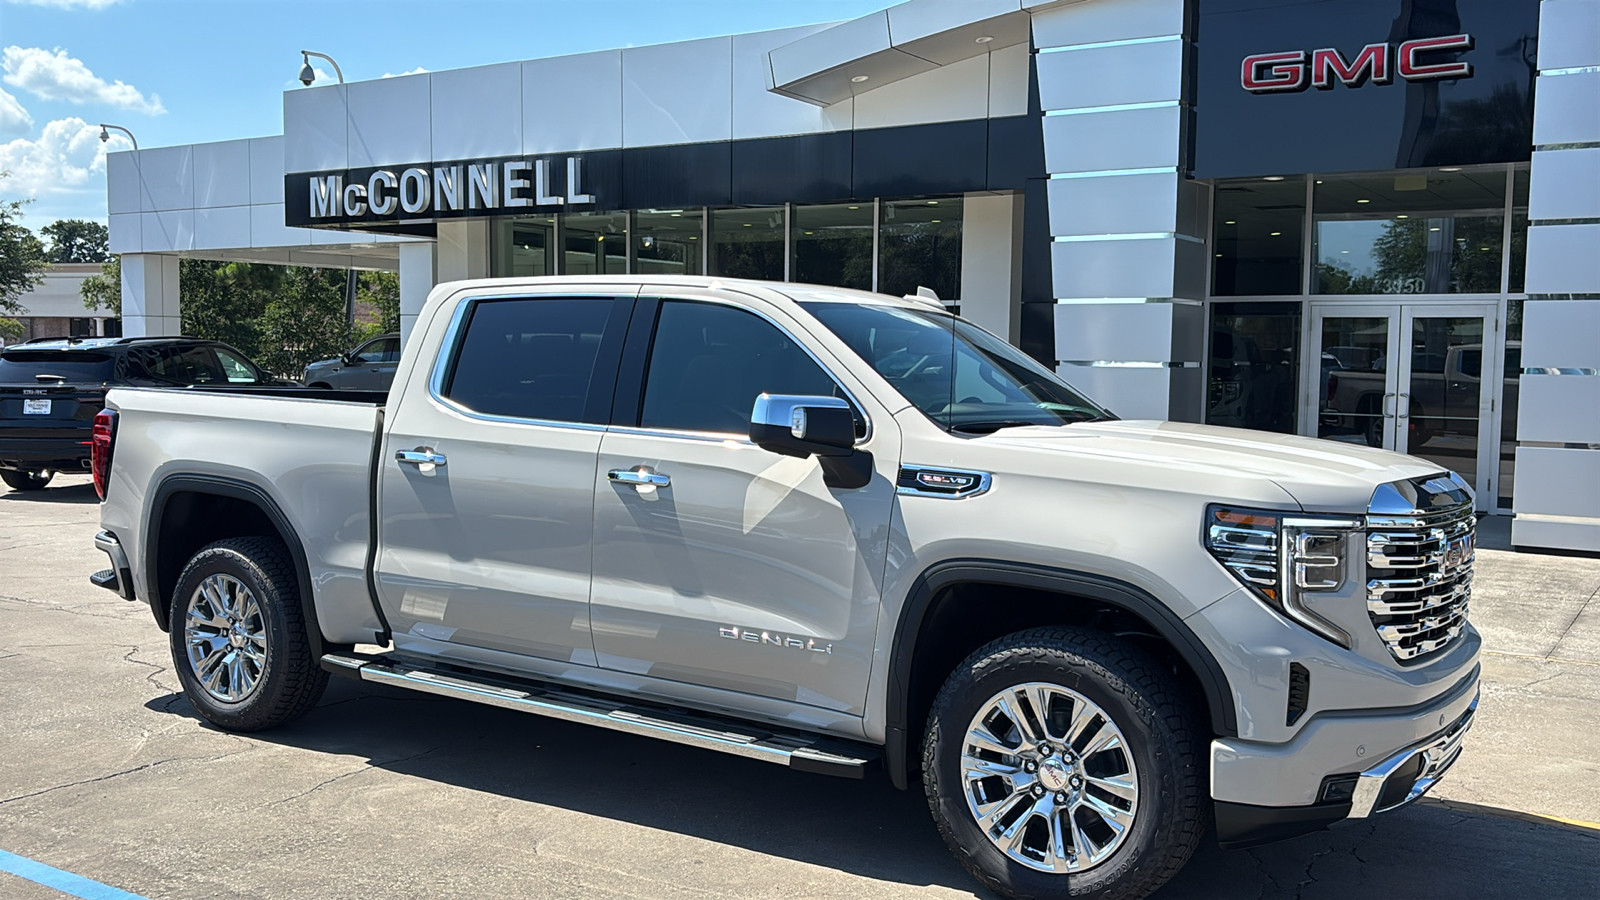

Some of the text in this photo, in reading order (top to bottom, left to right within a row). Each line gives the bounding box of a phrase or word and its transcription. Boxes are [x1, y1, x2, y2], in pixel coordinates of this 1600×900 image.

[1241, 33, 1472, 93] GMC
[309, 157, 596, 218] McCONNELL
[1446, 534, 1476, 567] GM
[719, 626, 832, 655] DENALI
[1044, 763, 1062, 787] GMC
